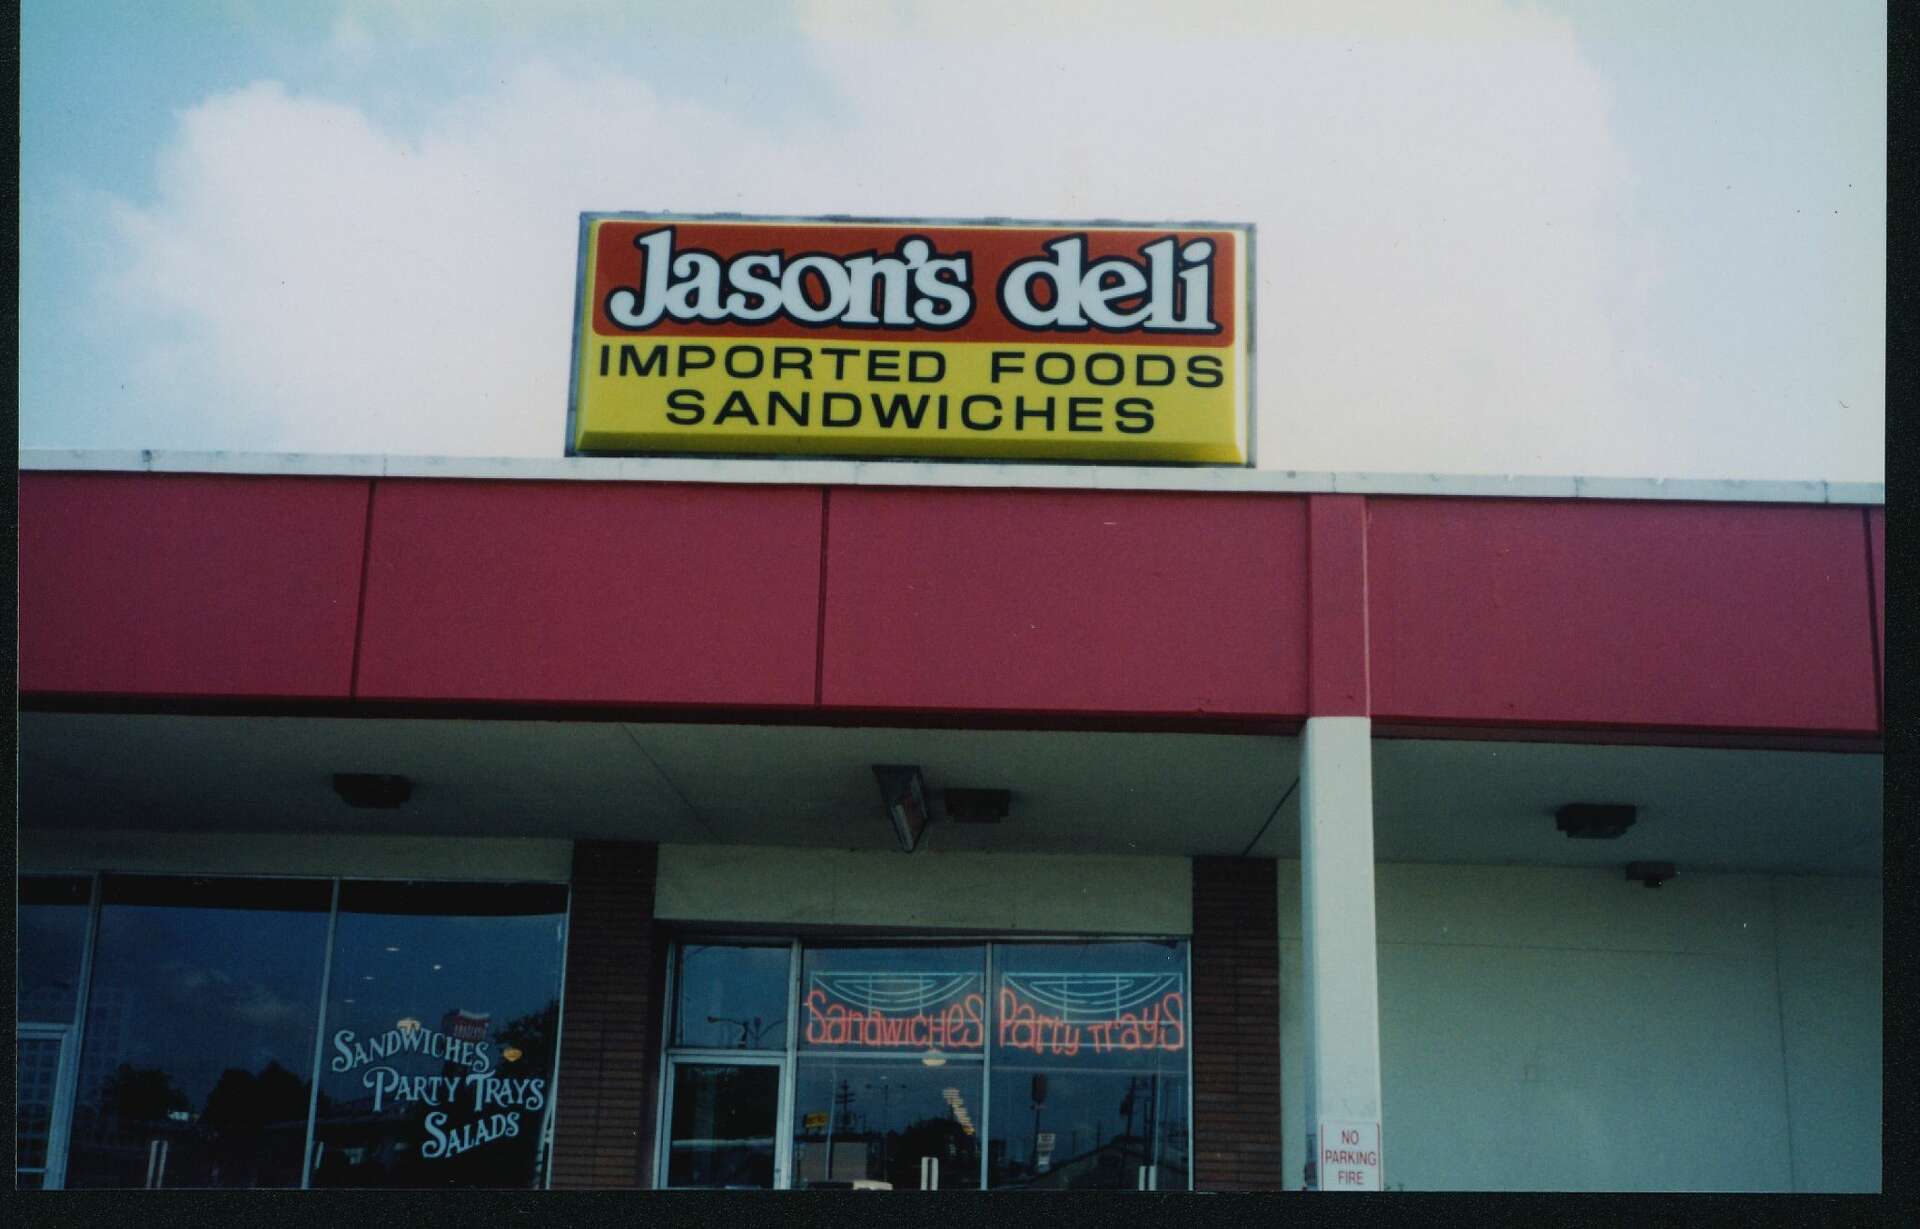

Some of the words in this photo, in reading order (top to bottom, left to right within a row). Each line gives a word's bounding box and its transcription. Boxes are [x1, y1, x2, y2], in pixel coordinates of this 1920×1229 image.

[606, 226, 975, 331] Jason's
[997, 233, 1222, 334] deli
[600, 344, 946, 383] IMPORTED
[991, 351, 1224, 388] FOODS
[665, 389, 1155, 434] SANDWICHES
[999, 987, 1081, 1056] Party
[331, 1029, 491, 1073] SANDWICHES
[362, 1065, 461, 1113] PARTY
[465, 1069, 545, 1113] TRAYS
[421, 1111, 520, 1159] SALADS
[1341, 1129, 1360, 1146] NO
[1325, 1150, 1377, 1167] PARKING
[1338, 1170, 1364, 1185] FIRE
